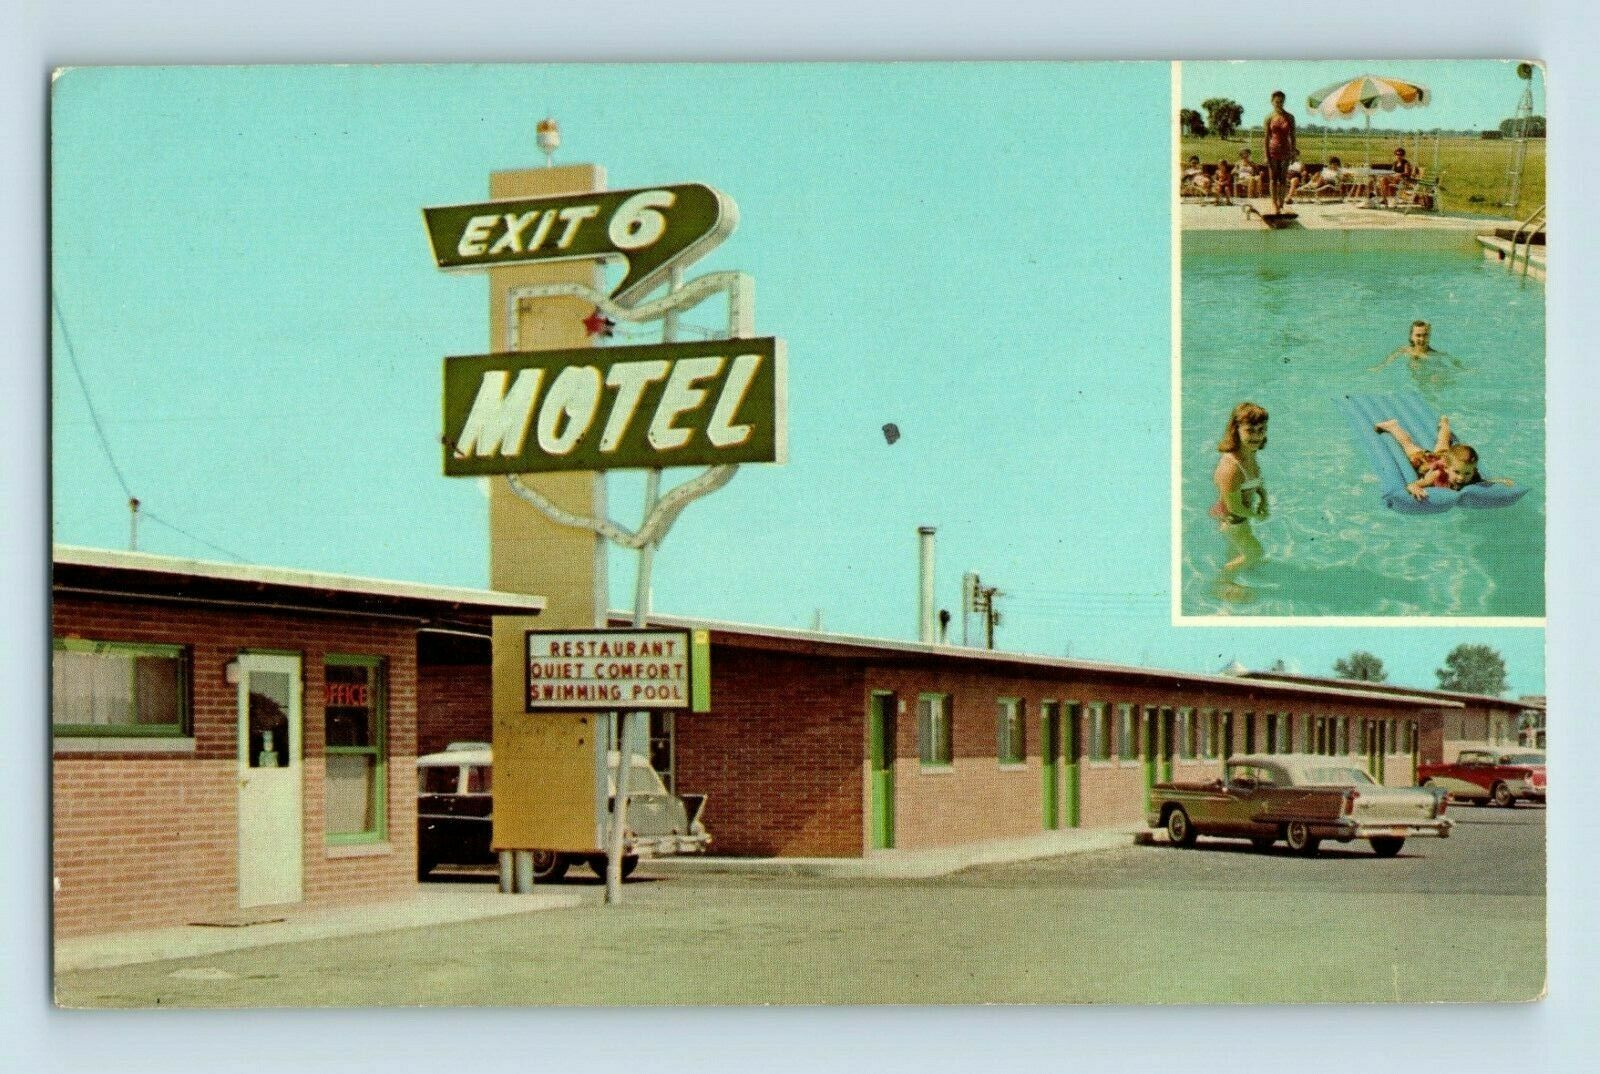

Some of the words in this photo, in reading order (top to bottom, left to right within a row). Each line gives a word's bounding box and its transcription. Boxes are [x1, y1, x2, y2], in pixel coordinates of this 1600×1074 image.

[458, 204, 599, 257] EXIT
[608, 190, 676, 250] 6
[453, 354, 764, 459] MOTEL
[550, 640, 676, 658] RESTAURANT
[531, 663, 584, 679] QUIET
[594, 663, 683, 679] COMFORT
[530, 684, 621, 701] SWIMMING
[632, 684, 682, 700] POOL
